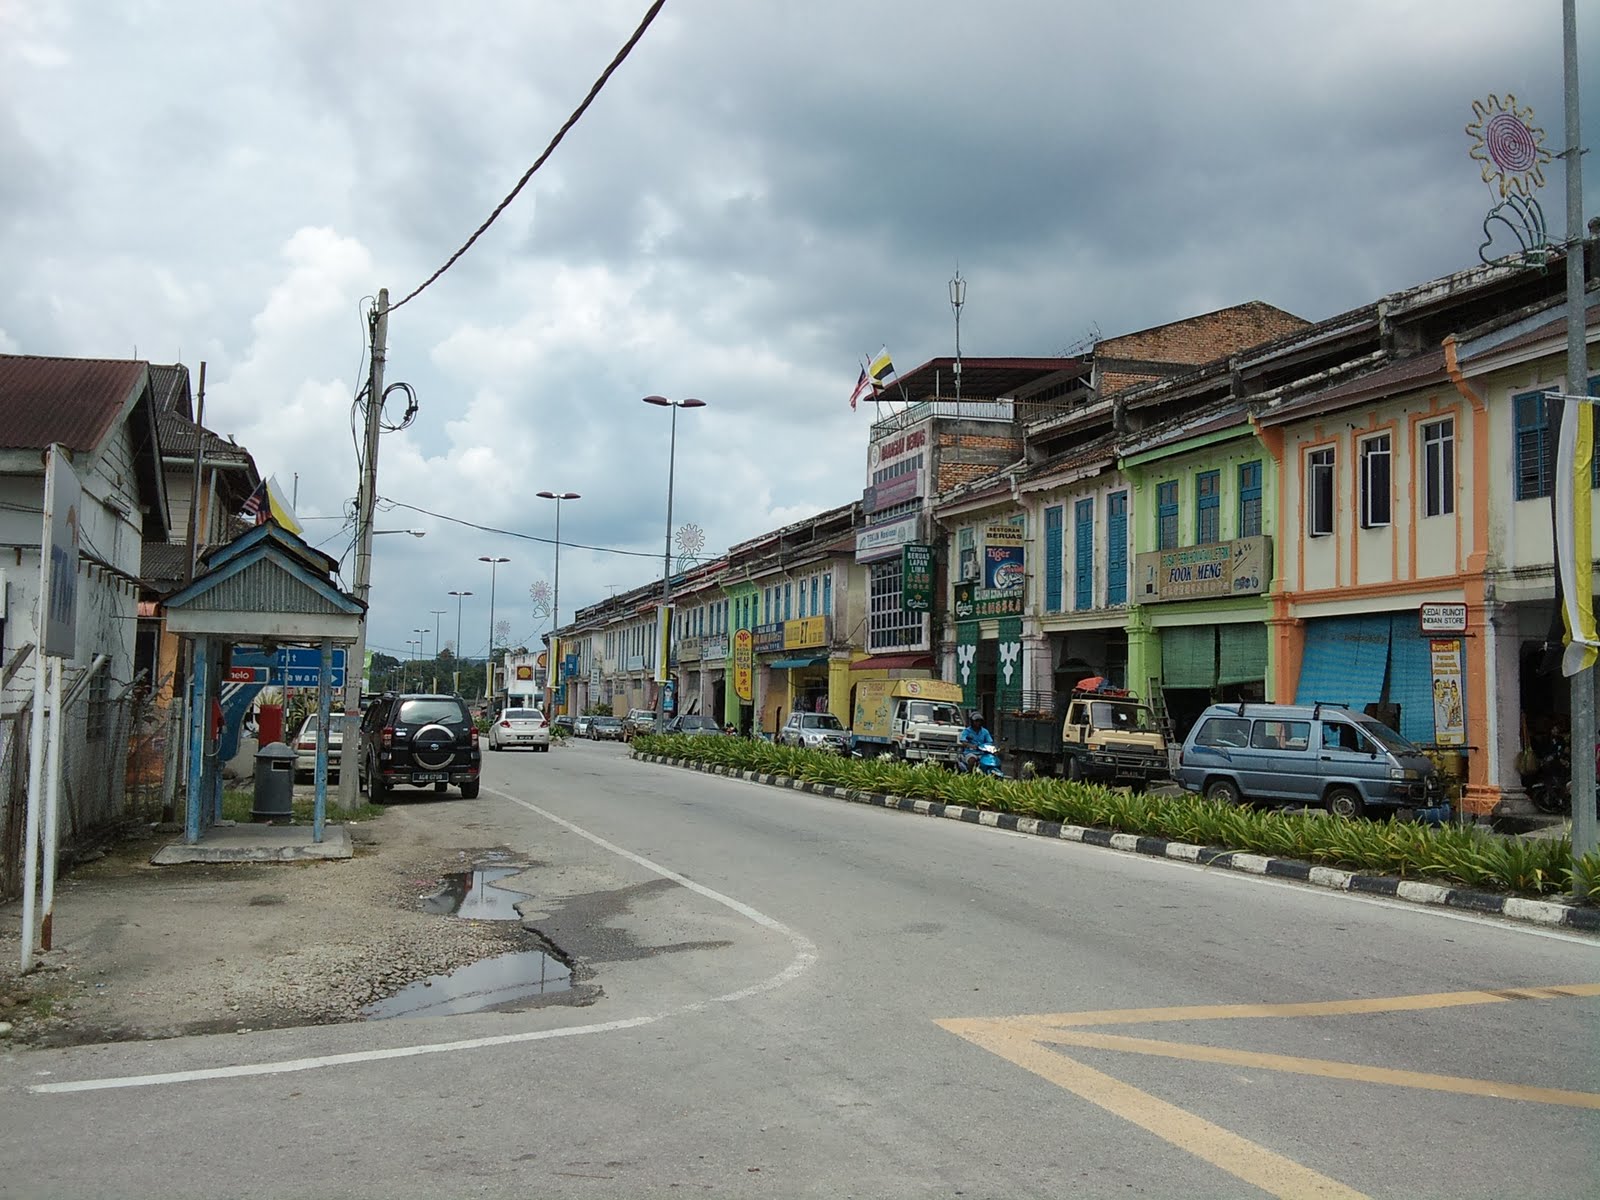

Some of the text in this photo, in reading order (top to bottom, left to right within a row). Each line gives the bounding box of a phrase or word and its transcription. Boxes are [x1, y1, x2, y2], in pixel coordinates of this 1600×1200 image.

[907, 552, 930, 560] BERUAS
[987, 547, 1011, 562] Tiger
[909, 559, 928, 567] LAPAN
[1169, 562, 1222, 583] FOOK MENG
[1423, 608, 1464, 616] KEDAI RUNCIT
